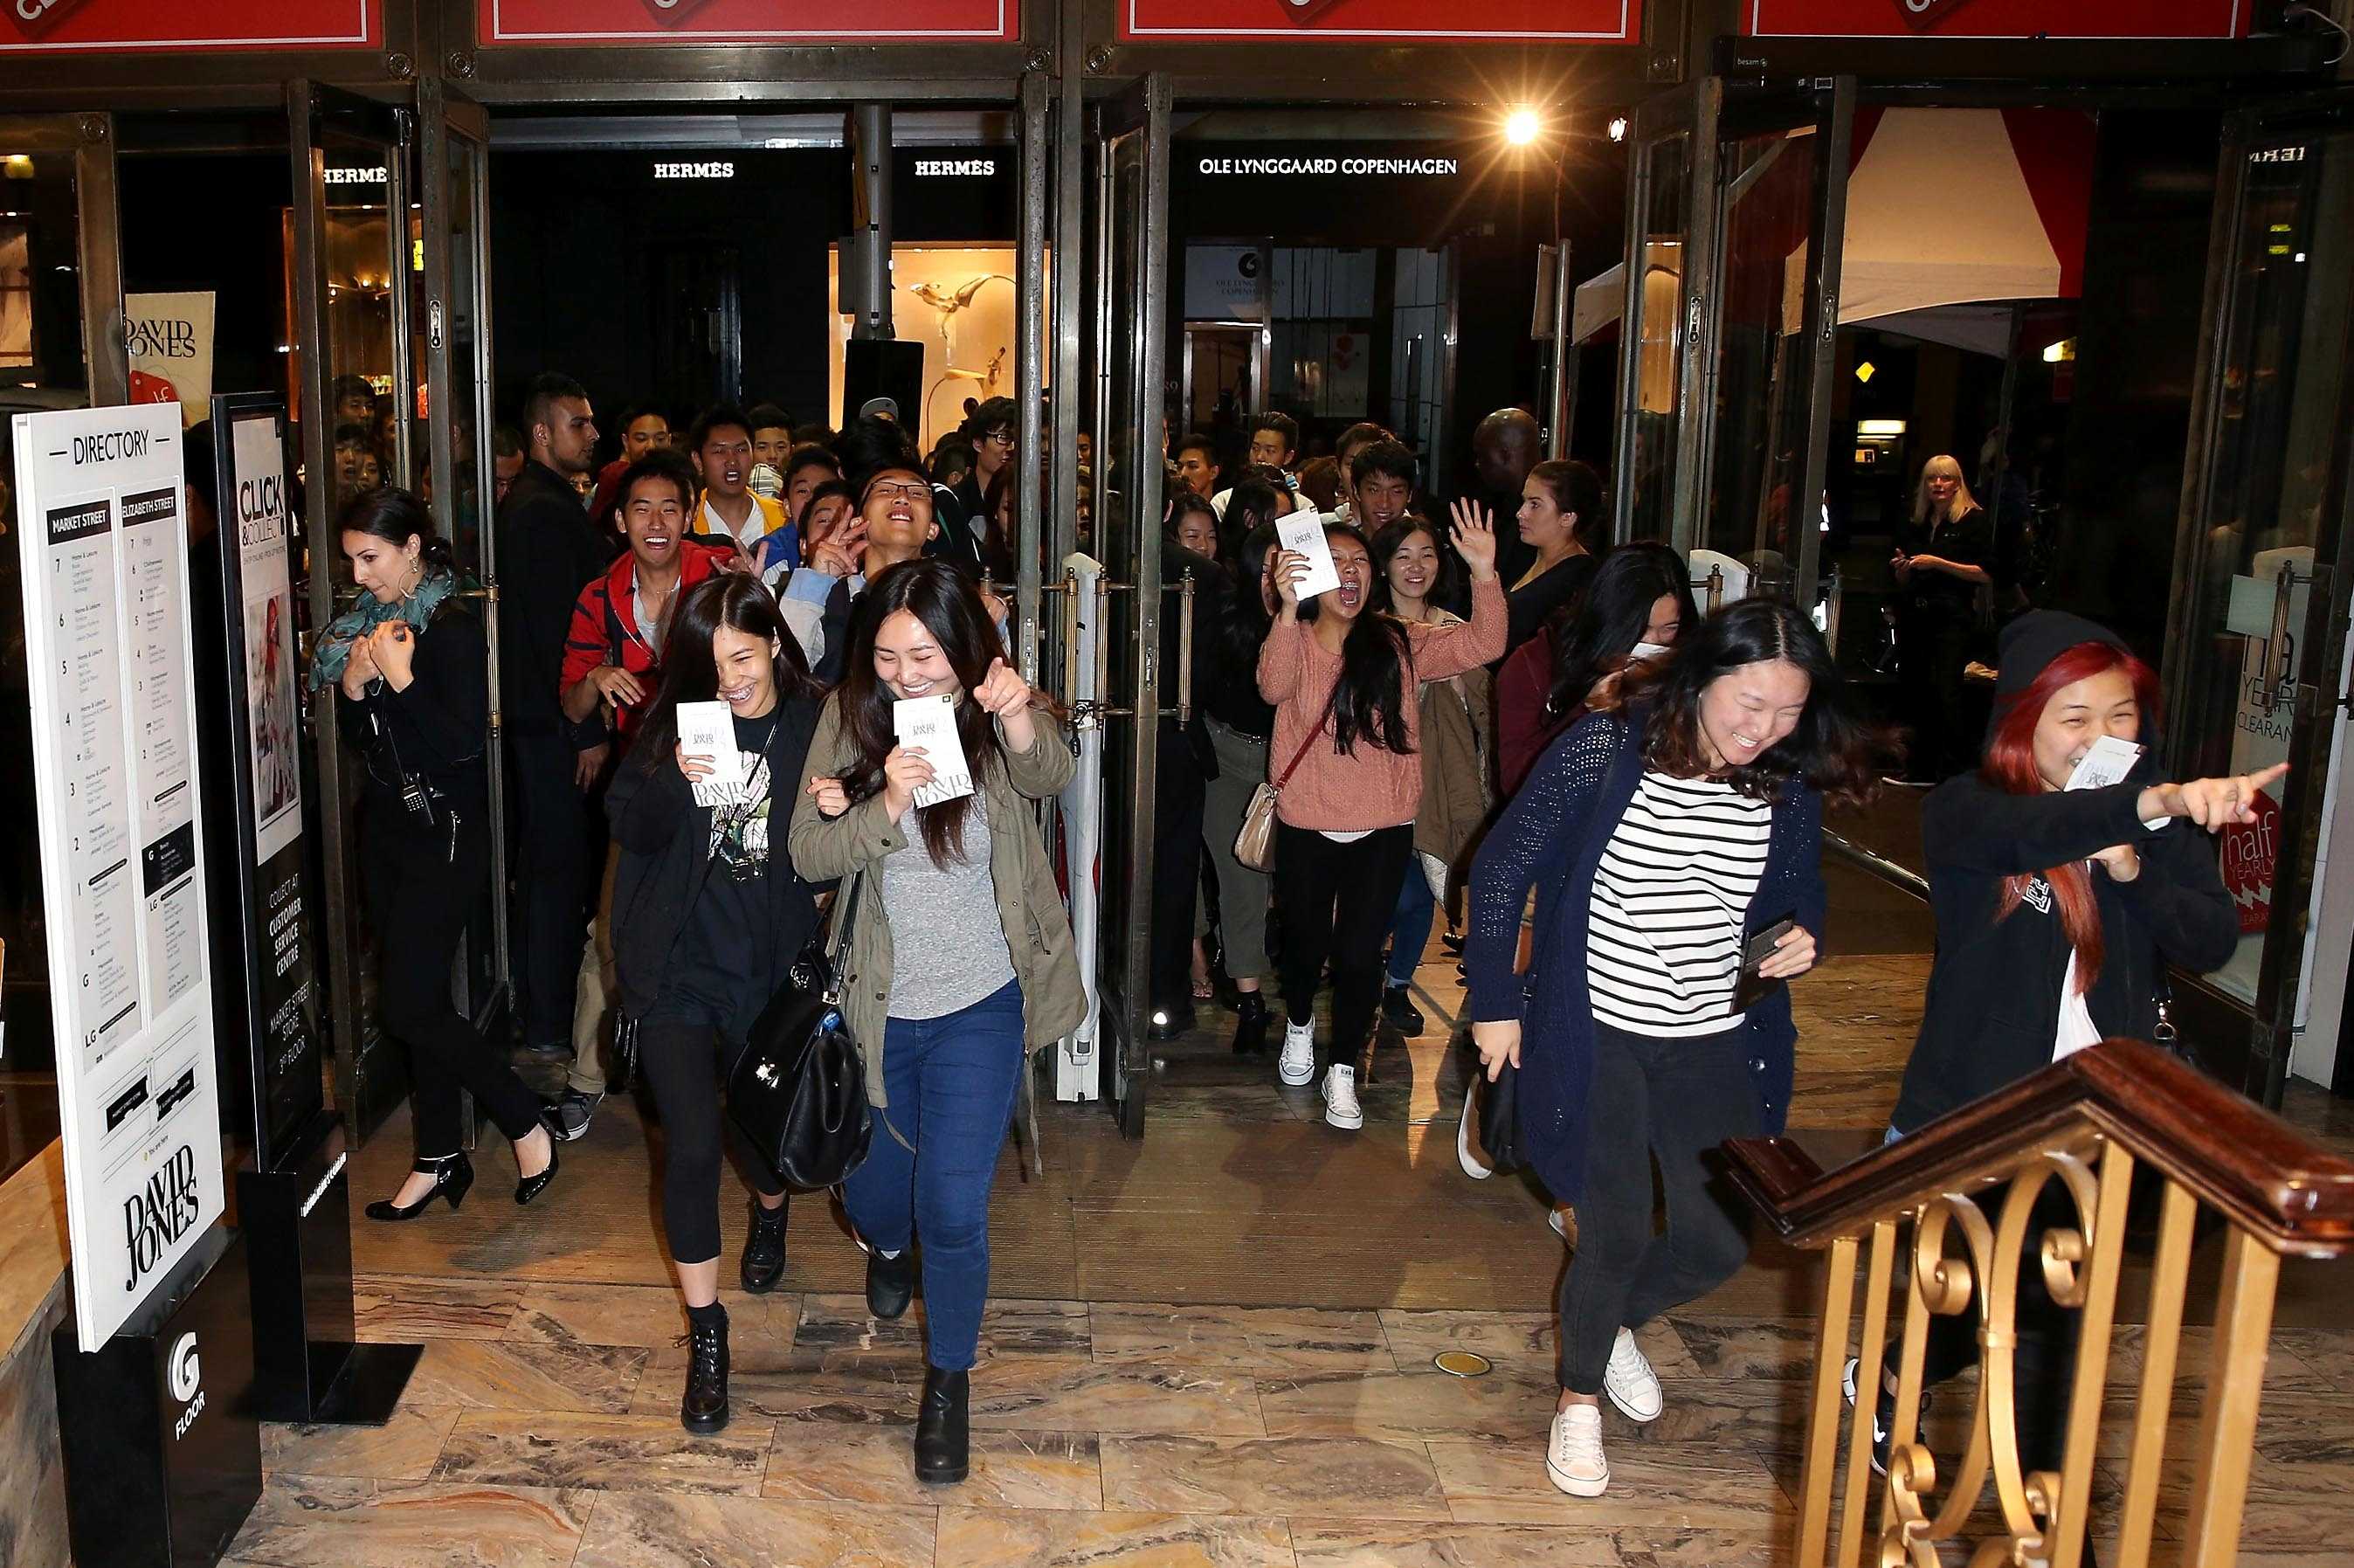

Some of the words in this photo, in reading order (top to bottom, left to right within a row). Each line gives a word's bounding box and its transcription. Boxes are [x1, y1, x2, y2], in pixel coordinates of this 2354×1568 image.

[1199, 159, 1231, 175] OLE
[1234, 159, 1336, 175] LYNGGAARD
[1341, 159, 1457, 175] COPENHAGEN
[129, 336, 197, 358] ONES
[73, 429, 149, 466] DIRECTORY
[122, 501, 154, 519] ELIZABETH
[154, 496, 175, 513] STREET
[240, 474, 284, 523] CLICK
[52, 515, 82, 534] MARKET
[82, 509, 107, 528] STREET
[56, 558, 60, 573] 7
[59, 613, 64, 627] 6
[62, 660, 67, 674] 5
[2242, 673, 2295, 716] YER
[66, 713, 71, 727] 4
[70, 783, 75, 797] 3
[74, 837, 79, 852] 2
[2227, 810, 2275, 865] half
[148, 850, 154, 861] G
[269, 879, 291, 909] COLLECT
[291, 873, 299, 891] AT
[149, 900, 158, 912] LG
[268, 897, 302, 937] CUSTOMER
[274, 922, 299, 957] SERVICE
[275, 945, 299, 977] CENTRE
[82, 974, 90, 987] G
[269, 1001, 292, 1035] MARKET
[291, 981, 309, 1012] STREET
[85, 1029, 97, 1048] LG
[282, 1018, 300, 1042] STORE
[123, 1144, 197, 1246] DAVID
[125, 1177, 199, 1292] JONES
[167, 1331, 202, 1403] G
[175, 1392, 206, 1440] FLOOR
